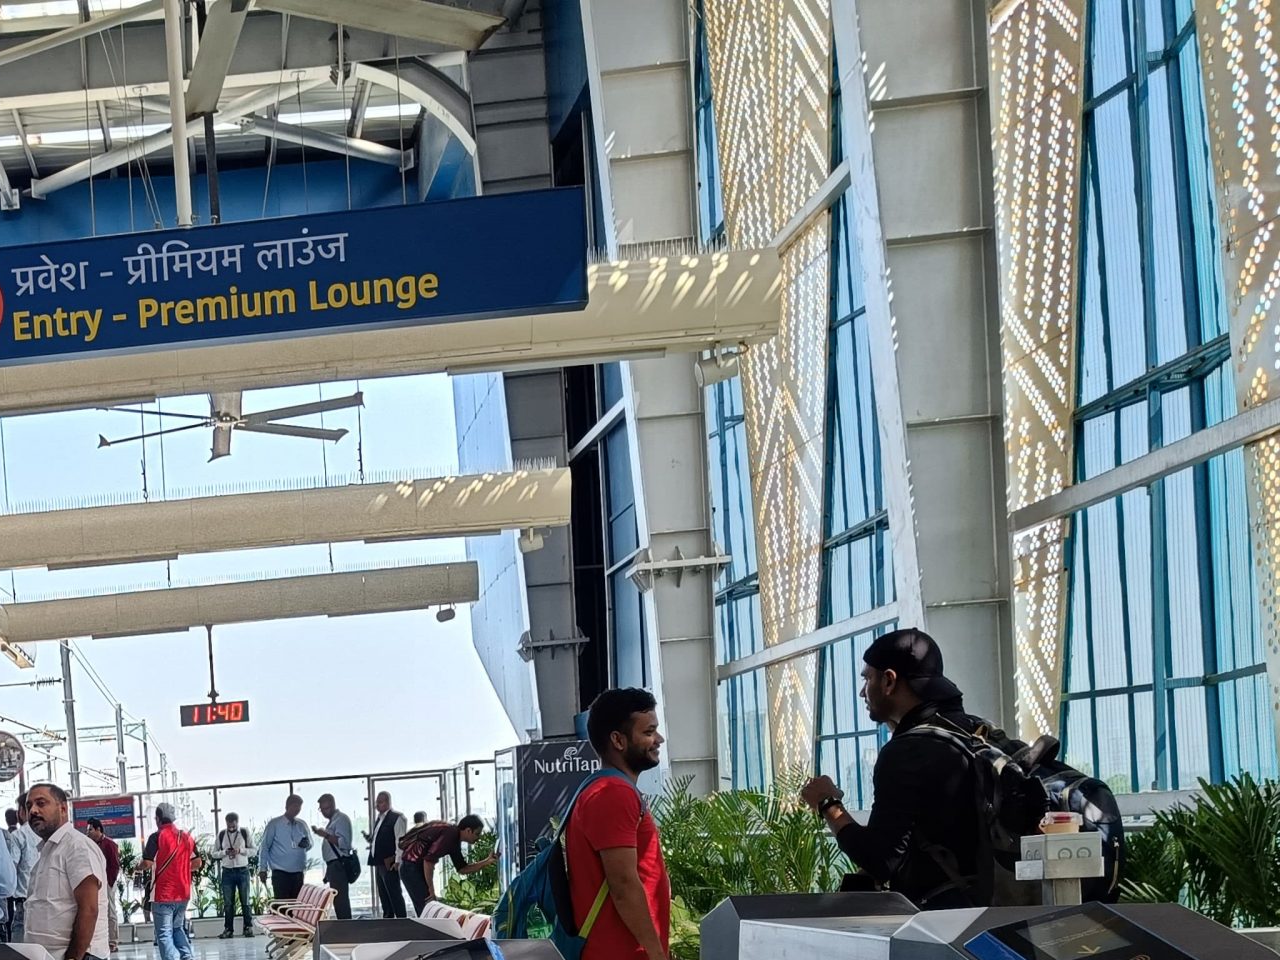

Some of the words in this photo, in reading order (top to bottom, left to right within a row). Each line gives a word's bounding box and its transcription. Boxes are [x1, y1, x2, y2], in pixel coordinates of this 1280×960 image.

[11, 254, 89, 297] प्रवेश
[123, 239, 245, 286] प्रीमियम
[253, 227, 349, 271] लाउंज
[13, 307, 103, 342] Entry
[138, 285, 297, 329] Premium
[308, 272, 439, 310] Lounge
[193, 702, 244, 723] 11:40
[534, 756, 600, 774] NutriTap
